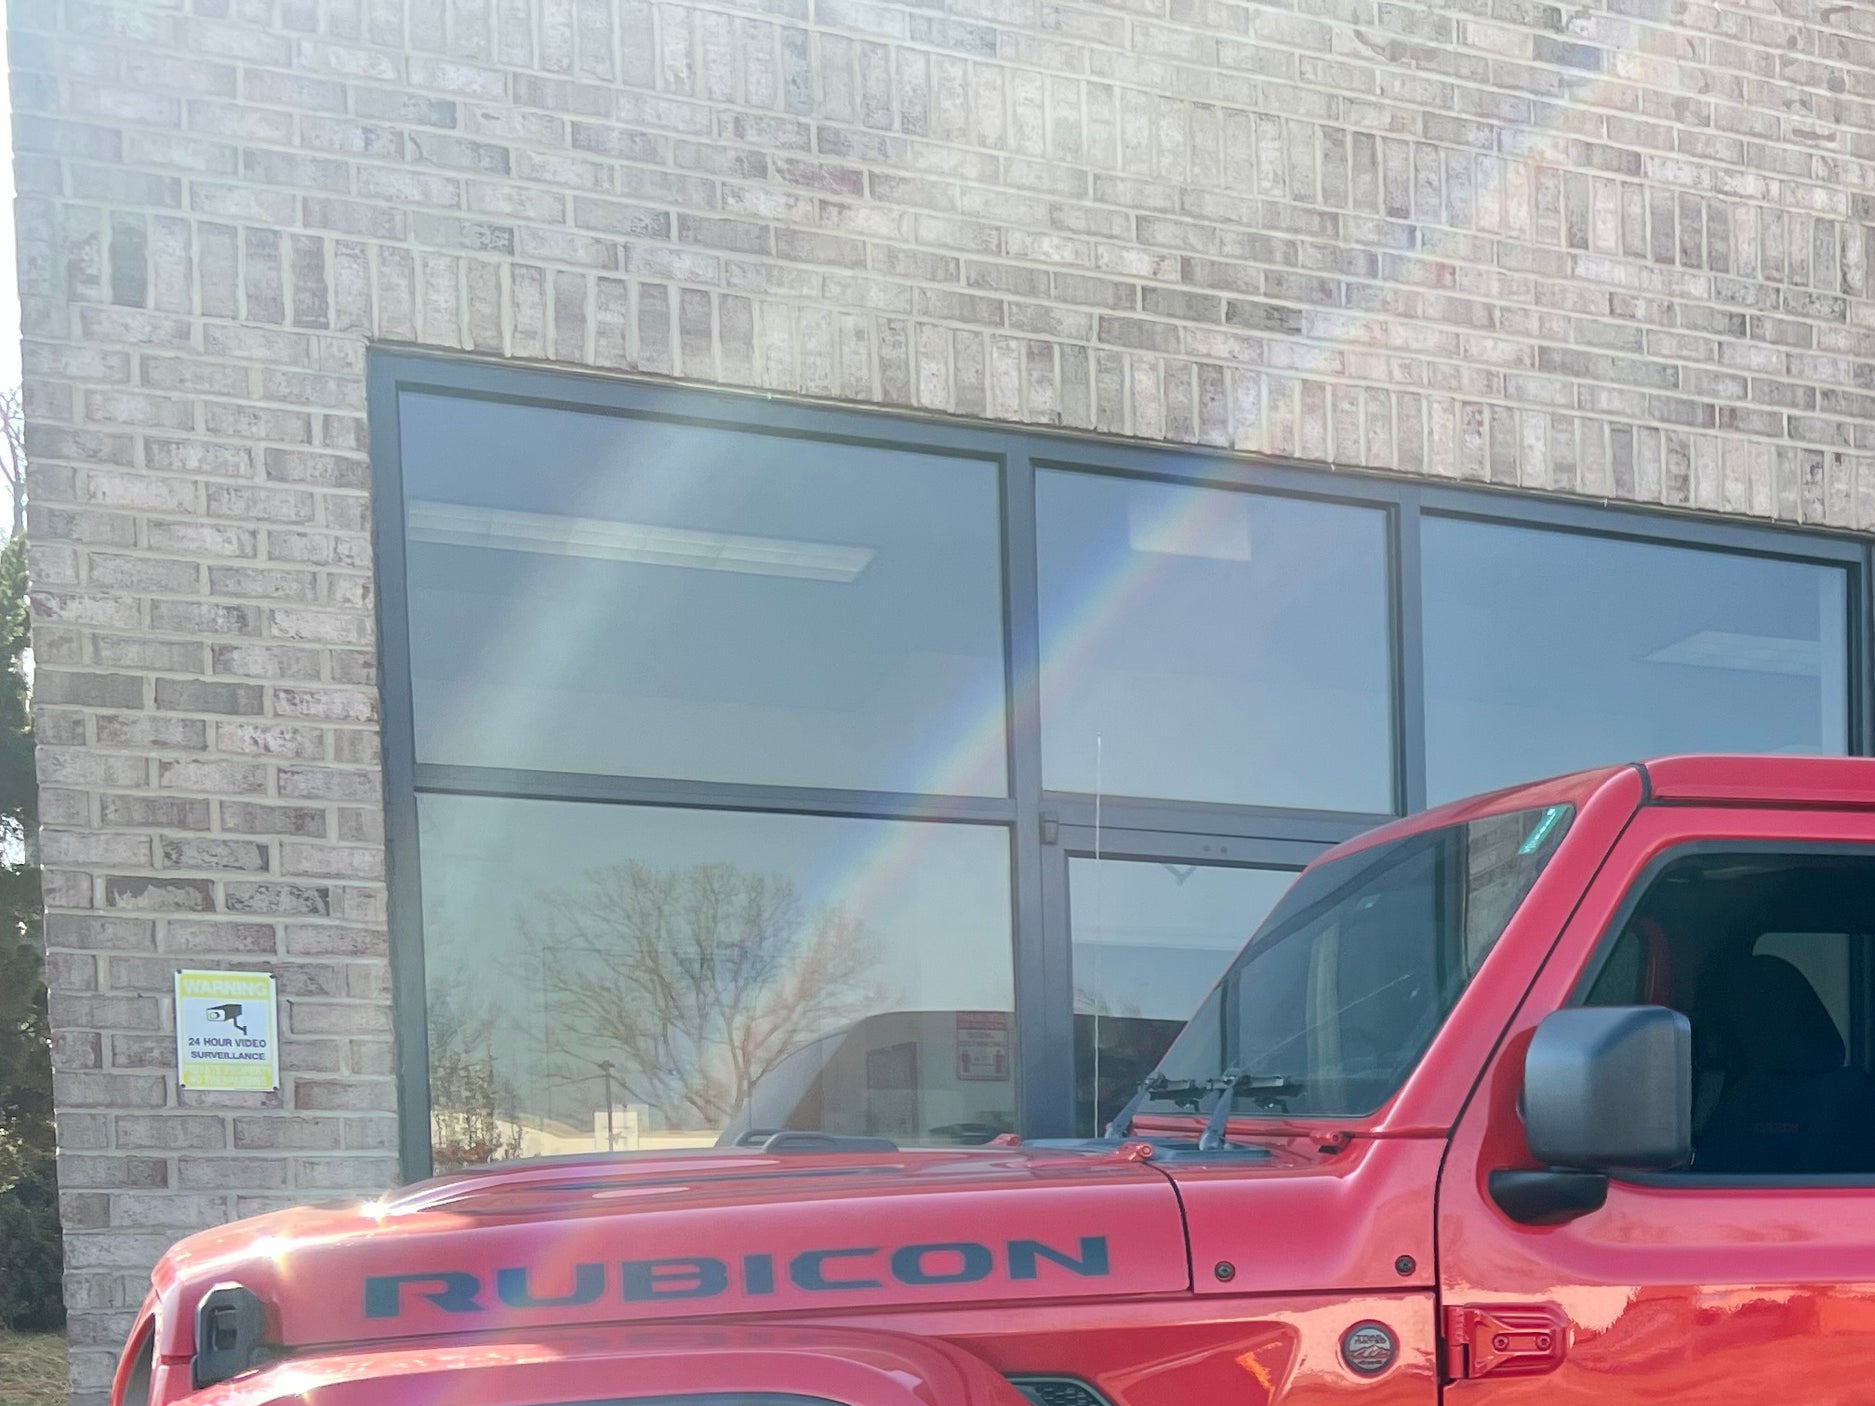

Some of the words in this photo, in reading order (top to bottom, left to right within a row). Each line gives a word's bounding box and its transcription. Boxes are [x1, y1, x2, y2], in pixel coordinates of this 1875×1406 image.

[182, 979, 267, 997] WARNING
[188, 1037, 201, 1047] 24
[203, 1037, 233, 1048] HOUR
[235, 1038, 267, 1049] VIDEO
[190, 1050, 267, 1061] SURVEILLANCE
[363, 1234, 1110, 1319] RUBICON
